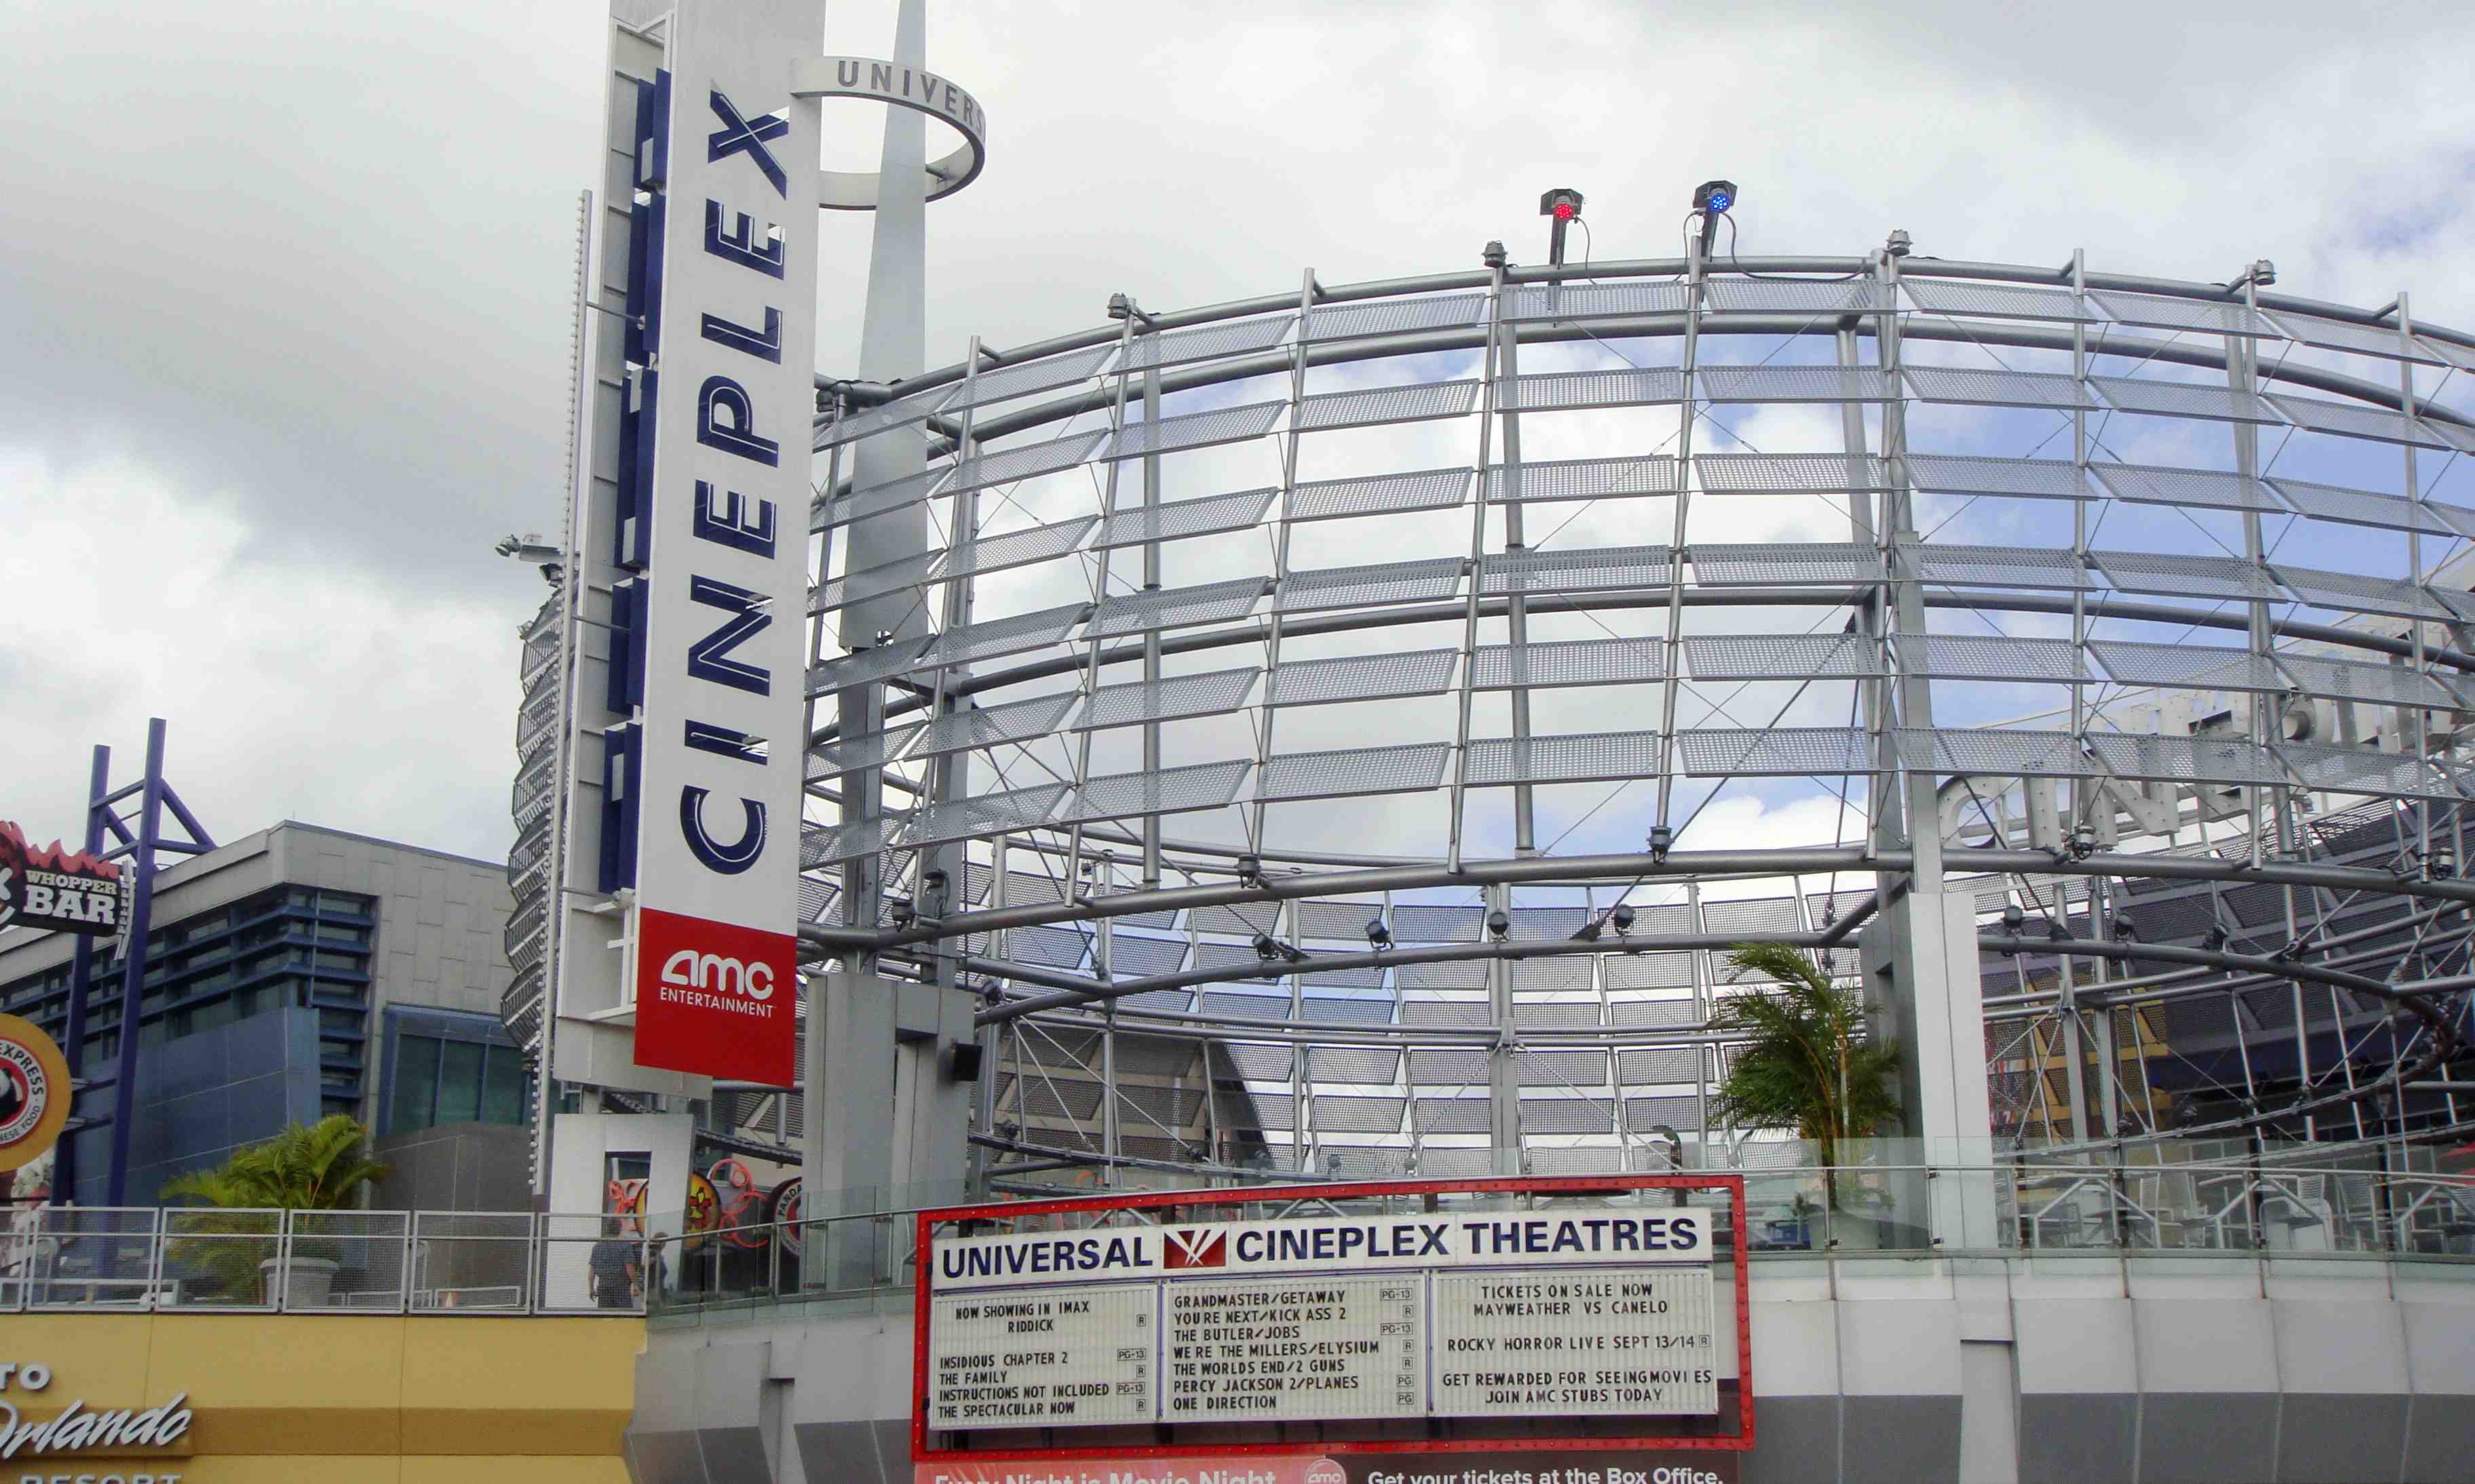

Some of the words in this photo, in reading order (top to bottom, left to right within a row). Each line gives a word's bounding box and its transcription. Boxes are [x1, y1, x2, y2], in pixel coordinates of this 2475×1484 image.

[679, 79, 790, 876] CINEPLEX
[26, 870, 117, 895] WHOPPER
[23, 884, 115, 924] BAR
[660, 987, 774, 1018] ENTERTAINMENT
[943, 1236, 1153, 1278] UNIVERSAL
[1236, 1224, 1449, 1262] CINEPLEX
[1463, 1218, 1697, 1254] THEATRES
[1174, 1290, 1346, 1308] GRANDMASTER/GETAWAY
[1381, 1290, 1411, 1299] PG-13
[1482, 1285, 1541, 1299] TICKETS
[1548, 1285, 1568, 1298] ON
[1575, 1284, 1612, 1297] SALE
[1622, 1283, 1653, 1296] NOW
[956, 1307, 978, 1319] NOW
[984, 1304, 1034, 1318] SHOWING
[1039, 1302, 1050, 1314] IN
[1059, 1301, 1090, 1314] IMAX
[1227, 1309, 1300, 1323] NEXT/KICK
[1306, 1308, 1331, 1321] ASS
[1340, 1307, 1347, 1320] 2
[1474, 1302, 1571, 1316] MAYWEATHER
[1584, 1301, 1602, 1314] VS
[1612, 1300, 1668, 1314] CANELO
[1008, 1319, 1054, 1333] RIDDICK
[1174, 1329, 1196, 1342] THE
[1204, 1326, 1299, 1341] BUTLER/JOBS
[1382, 1325, 1412, 1333] PG-13
[1221, 1344, 1243, 1357] THE
[1249, 1341, 1379, 1357] MILLERS/ELYSIUM
[1448, 1337, 1495, 1352] ROCKY
[1504, 1337, 1562, 1350] HORROR
[1571, 1336, 1605, 1350] LIVE
[1613, 1335, 1649, 1349] SEPT
[1655, 1335, 1695, 1348] 13/14
[940, 1355, 995, 1369] INSIDIOUS
[1004, 1352, 1054, 1366] CHAPTER
[1062, 1352, 1068, 1363] 2
[1119, 1350, 1144, 1359] PG-13
[1174, 1363, 1195, 1376] THE
[1201, 1361, 1254, 1375] WORLDS
[1261, 1360, 1303, 1373] END/2
[1310, 1359, 1345, 1372] GUNS
[940, 1373, 958, 1385] THE
[965, 1371, 1008, 1384] FAMILY
[1174, 1380, 1216, 1393] PERCY
[1224, 1378, 1283, 1392] JACKSON
[1290, 1375, 1358, 1390] 2/PLANES
[1443, 1373, 1470, 1386] GET
[1476, 1372, 1552, 1386] REWARDED
[1559, 1371, 1586, 1385] FOR
[940, 1387, 1018, 1401] INSTRUCTIONS
[1024, 1386, 1045, 1398] NOT
[1053, 1384, 1109, 1397] INCLUDED
[1118, 1384, 1144, 1392] PG-13
[1486, 1390, 1519, 1404] JOIN
[1526, 1390, 1556, 1403] AMC
[1562, 1389, 1609, 1403] STUBS
[1615, 1388, 1662, 1402] TODAY
[938, 1406, 957, 1418] THE
[963, 1403, 1043, 1418] SPECTACULAR
[1050, 1401, 1075, 1414] NOW
[1174, 1397, 1197, 1410] ONE
[1207, 1395, 1276, 1409] DIRECTION
[1368, 1471, 1404, 1484] Get
[1463, 1470, 1533, 1484] tickets
[1539, 1469, 1559, 1484] at
[1565, 1468, 1600, 1484] the
[1607, 1468, 1647, 1484] Box
